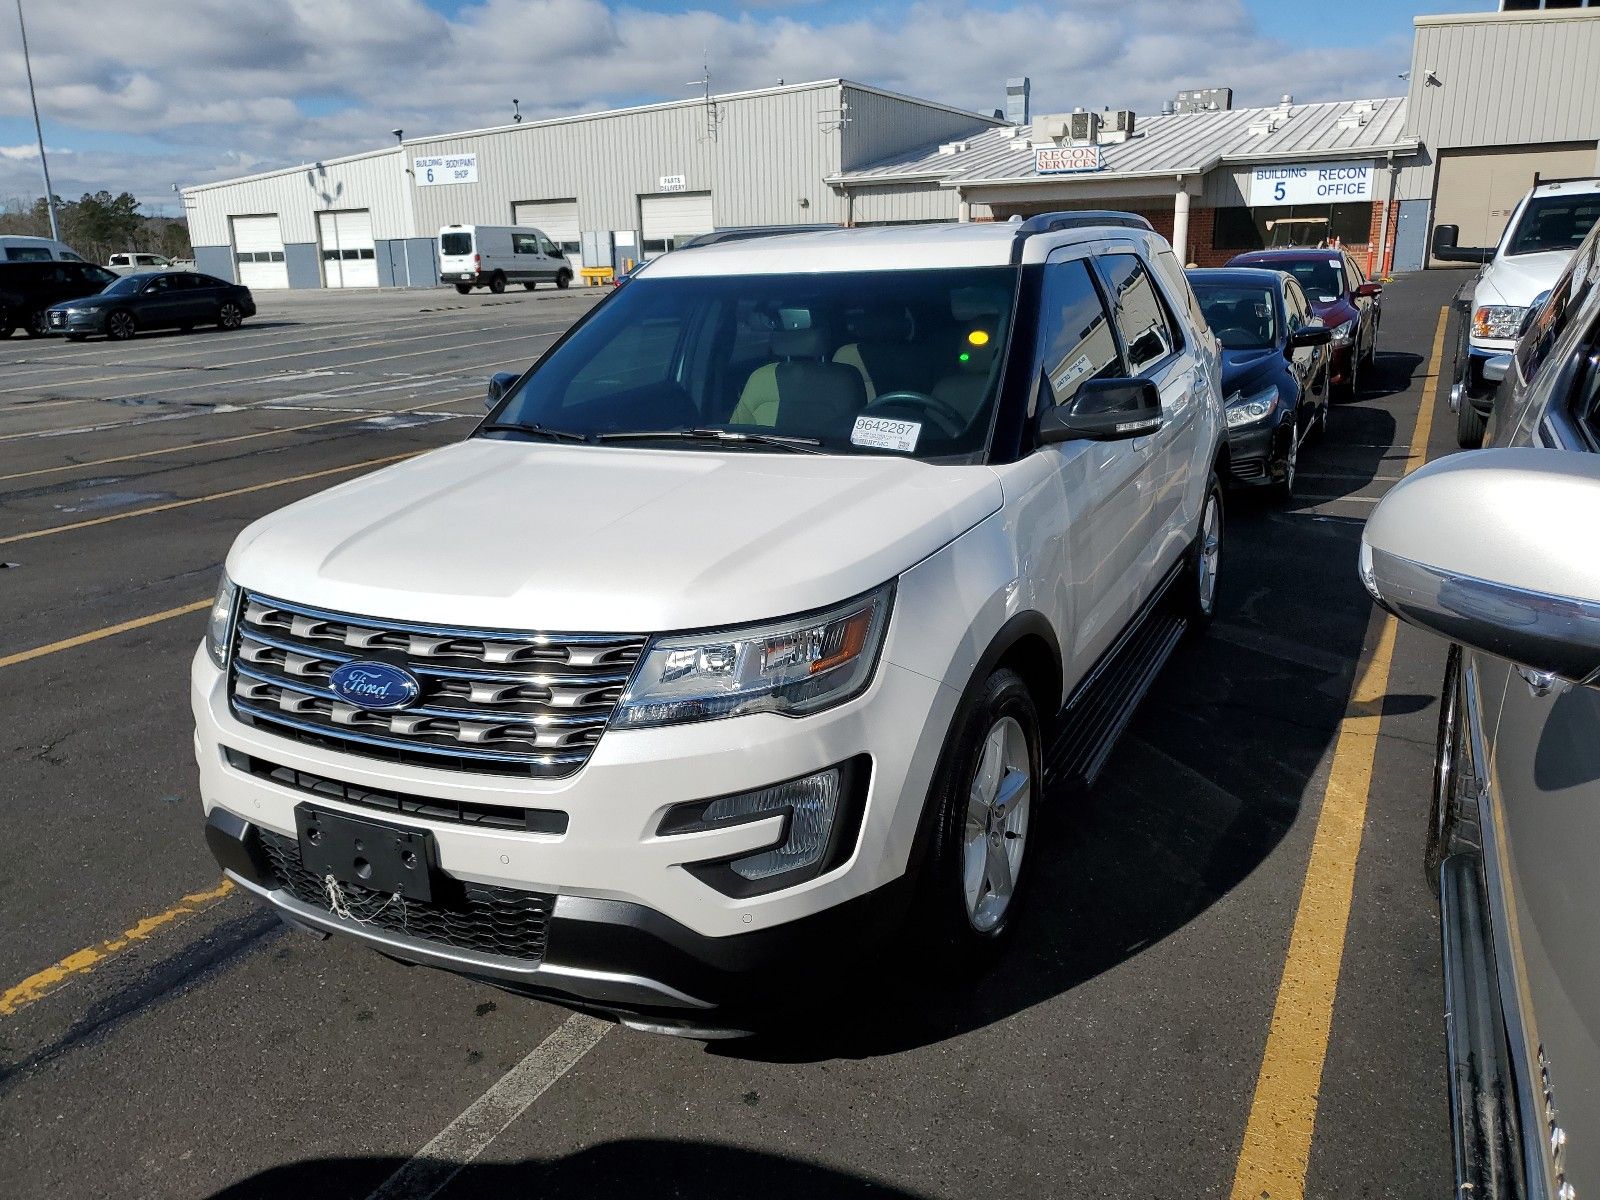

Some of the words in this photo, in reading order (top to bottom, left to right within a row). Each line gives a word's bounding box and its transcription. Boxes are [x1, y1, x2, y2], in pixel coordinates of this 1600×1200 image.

[1039, 148, 1097, 160] RECON
[416, 159, 442, 167] BUILDING
[1038, 159, 1097, 170] SERVICES
[427, 168, 434, 182] 6
[454, 169, 469, 179] SHOP
[1256, 168, 1307, 180] BUILDING
[1318, 167, 1367, 180] RECON
[1274, 182, 1286, 201] 5
[1317, 182, 1366, 196] OFFICE
[855, 419, 914, 435] 9642287
[343, 670, 392, 699] Ford
